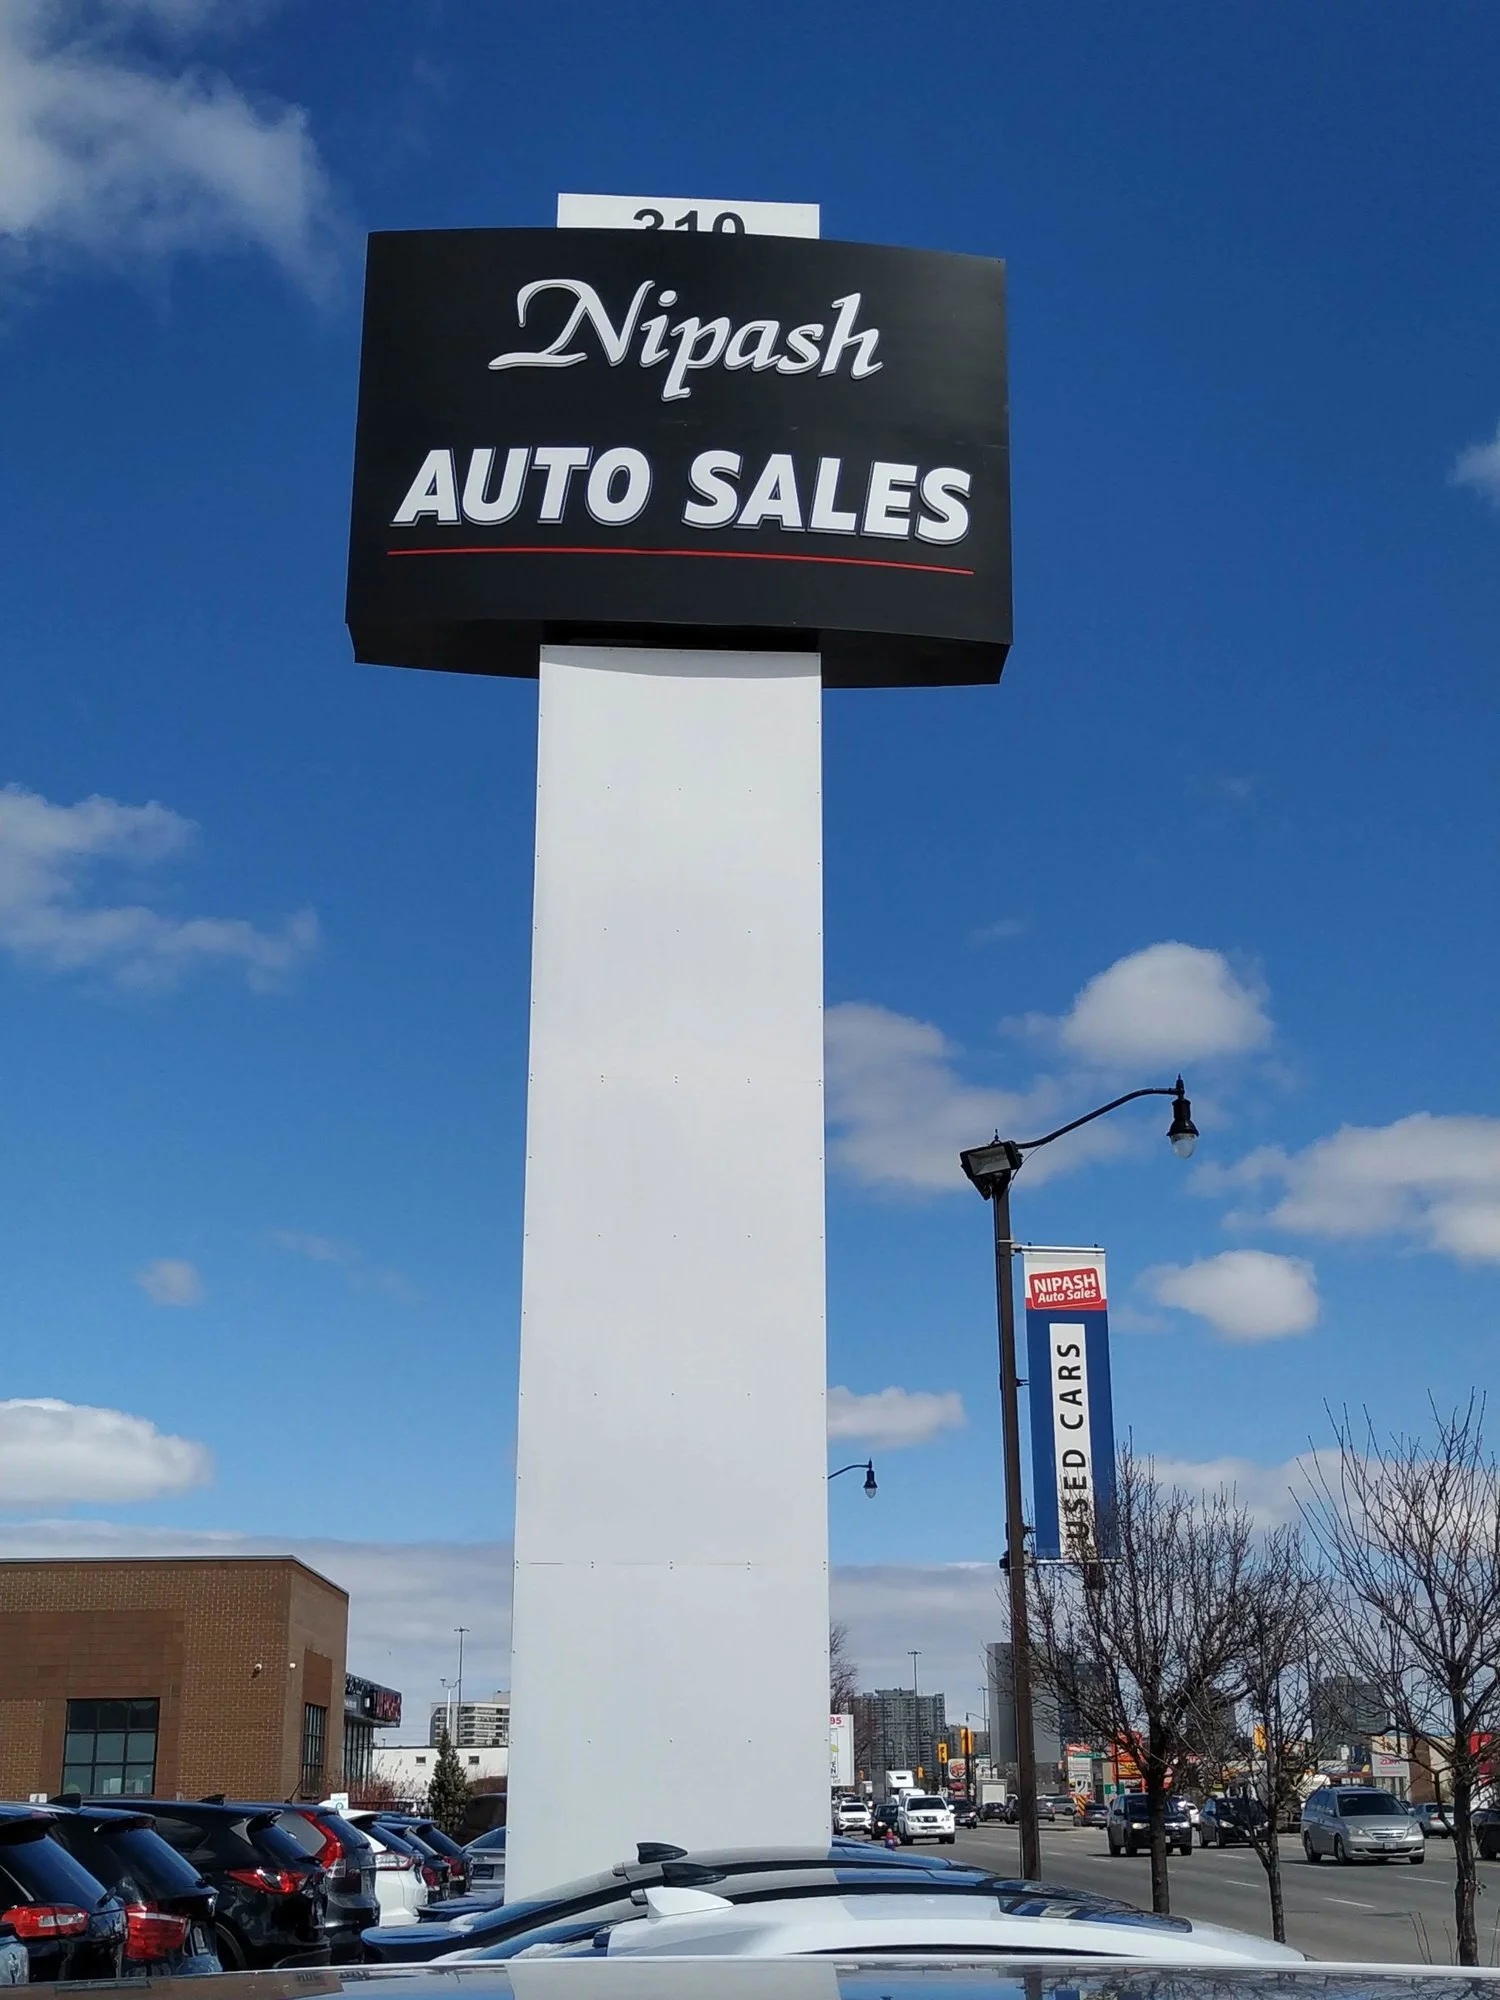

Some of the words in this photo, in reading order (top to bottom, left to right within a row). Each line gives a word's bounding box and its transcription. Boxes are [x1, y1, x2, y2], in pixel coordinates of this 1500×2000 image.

[488, 279, 883, 401] Nipash
[389, 446, 652, 527] AUTO
[681, 450, 973, 545] SALES
[1033, 1273, 1097, 1293] NIPASH
[1037, 1292, 1065, 1304] Auto
[1066, 1287, 1097, 1300] Sales
[1057, 1343, 1084, 1430] CARS
[1062, 1449, 1090, 1539] USED
